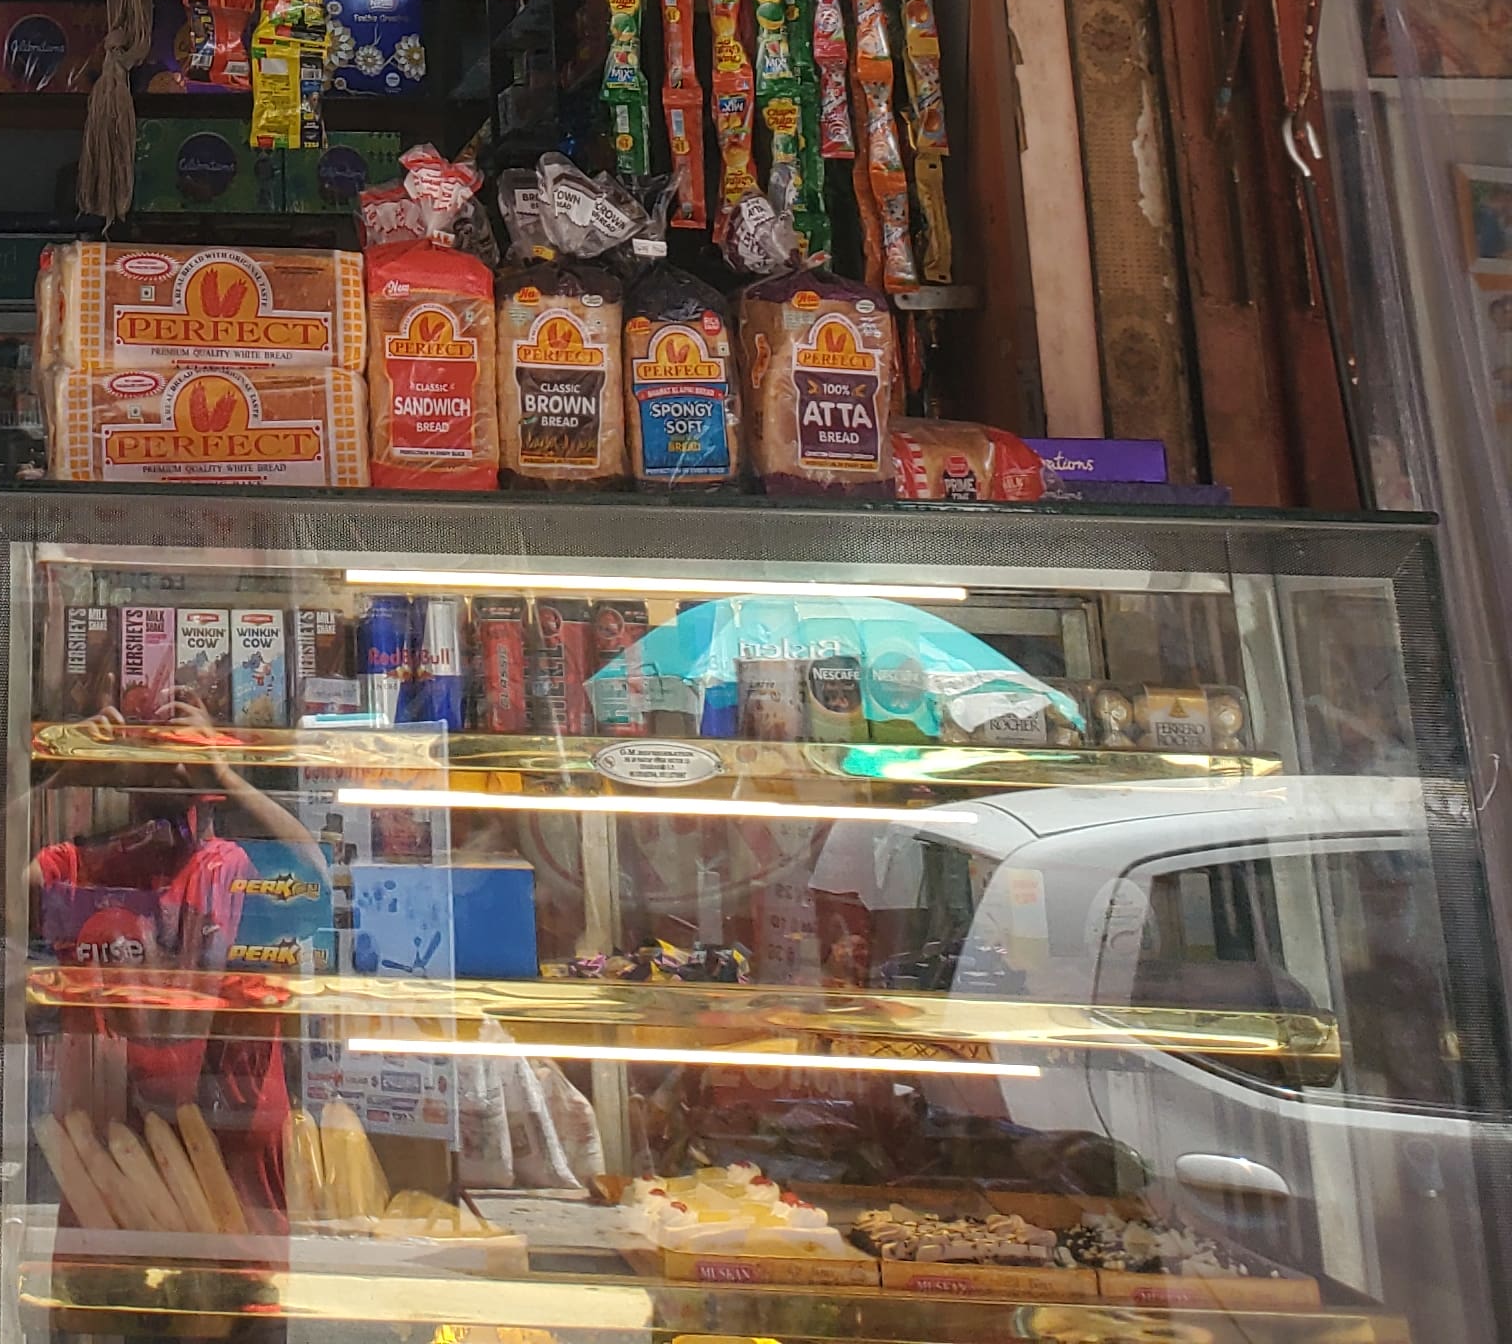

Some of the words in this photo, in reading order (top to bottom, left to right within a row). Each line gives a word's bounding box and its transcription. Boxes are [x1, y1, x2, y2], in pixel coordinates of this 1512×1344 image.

[204, 251, 228, 262] WITH
[127, 317, 320, 345] PERFECT
[151, 348, 190, 358] PREMIUM
[193, 348, 230, 359] QUALITY
[232, 350, 262, 360] WHITE
[264, 351, 293, 361] BREAD
[394, 341, 467, 357] PERFECT
[522, 347, 596, 363] PERFECT
[802, 352, 870, 369] PERFECT
[643, 364, 715, 378] PERFECT
[415, 382, 450, 393] CLASSIC
[540, 382, 581, 394] CLASSIC
[822, 383, 851, 396] 100%
[394, 396, 472, 418] SANDWICH
[524, 395, 596, 415] BROWN
[650, 402, 714, 418] SPONGY
[541, 416, 579, 428] BREAD
[803, 400, 873, 429] ATTA
[416, 421, 450, 434] BREAD
[665, 419, 704, 435] SOFT
[818, 430, 861, 445] BREAD
[116, 432, 312, 459] PERFECT
[142, 465, 182, 474] PREMIUM
[184, 464, 223, 474] QUALITY
[226, 463, 255, 473] WHITE
[257, 462, 288, 472] BREAD
[145, 610, 165, 622] MILK
[67, 606, 87, 674] HERSHEY'S
[125, 609, 144, 676] HERSHEY'S
[187, 638, 219, 649] COW
[242, 638, 274, 649] COW
[368, 647, 400, 665] Red
[989, 719, 1040, 733] ROCHER
[699, 1266, 751, 1282] MUSKAN
